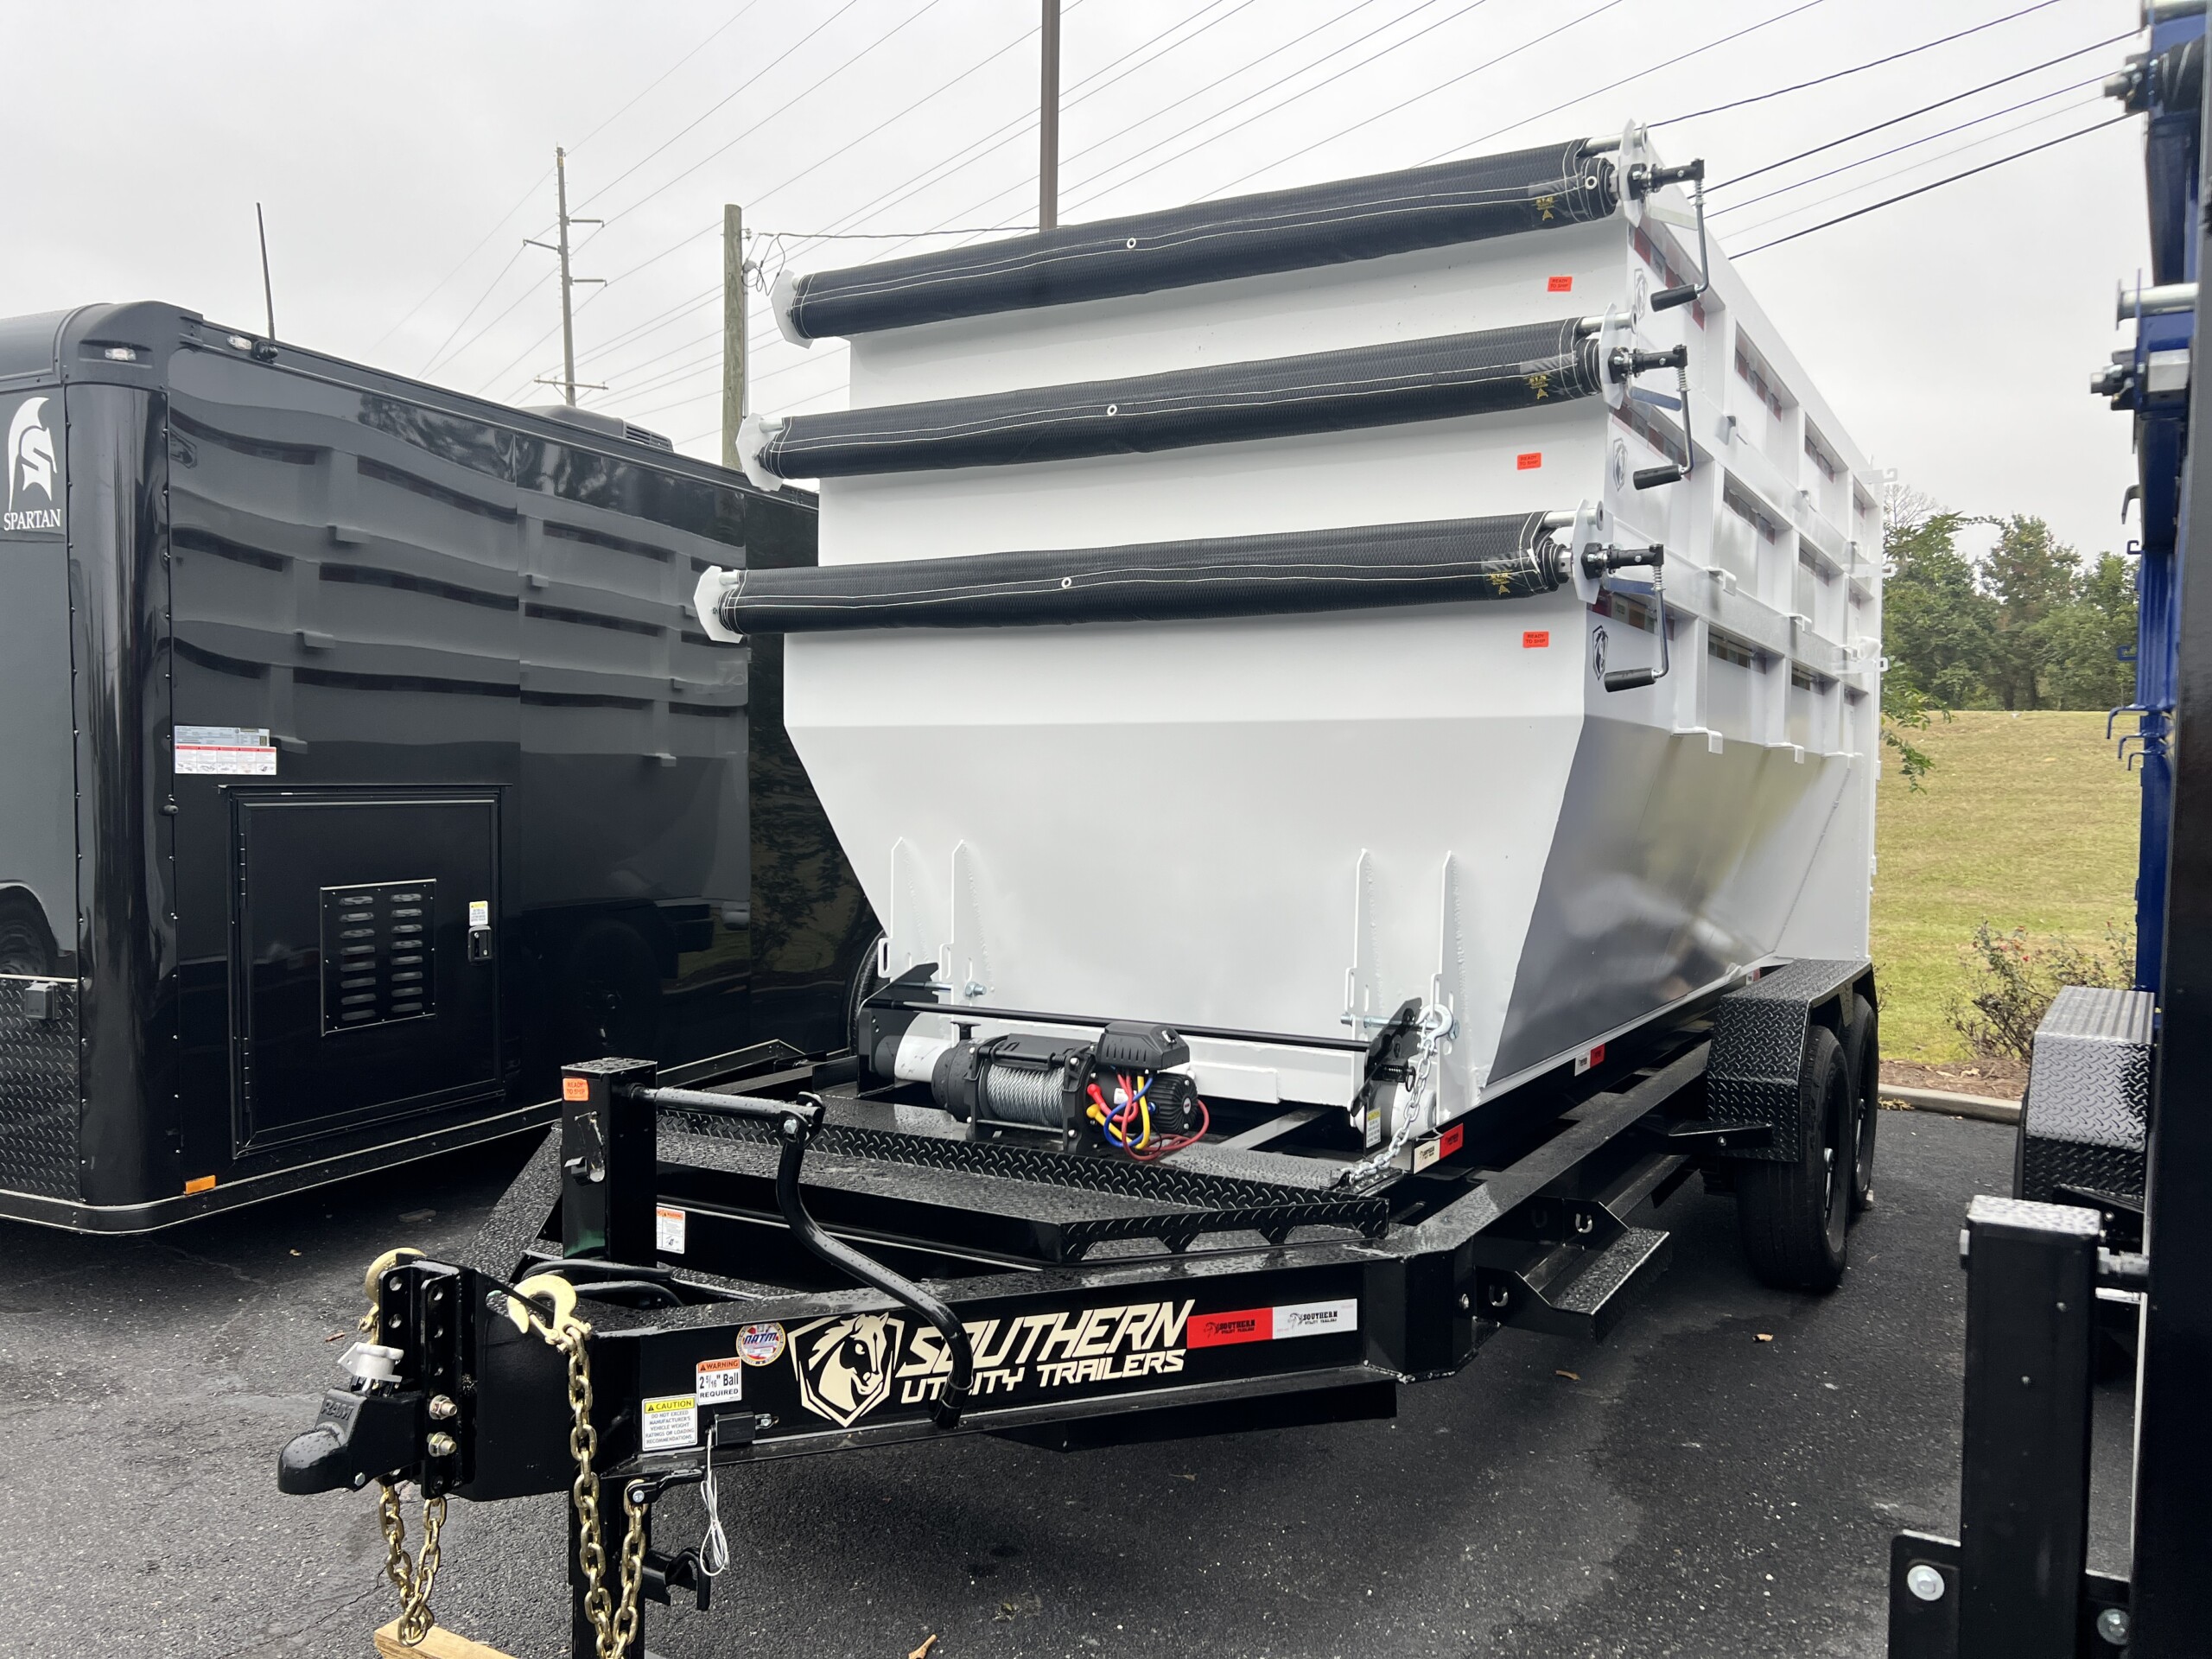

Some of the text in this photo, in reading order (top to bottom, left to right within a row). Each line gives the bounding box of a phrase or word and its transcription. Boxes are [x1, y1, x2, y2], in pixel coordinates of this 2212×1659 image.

[3, 508, 61, 531] SPARTAN
[1303, 1310, 1338, 1320] SOUTHERN
[1219, 1319, 1255, 1330] SOUTHERN
[743, 1332, 777, 1344] NATM
[706, 1360, 739, 1370] WARNING
[699, 1376, 705, 1389] 2
[722, 1371, 739, 1387] Ball
[900, 1349, 1187, 1404] UTITY TRAILERS
[699, 1389, 739, 1398] REQUIRED
[321, 1399, 354, 1421] RAM
[656, 1400, 692, 1410] CAUTION
[649, 1415, 691, 1425] MANUFACTURER'S
